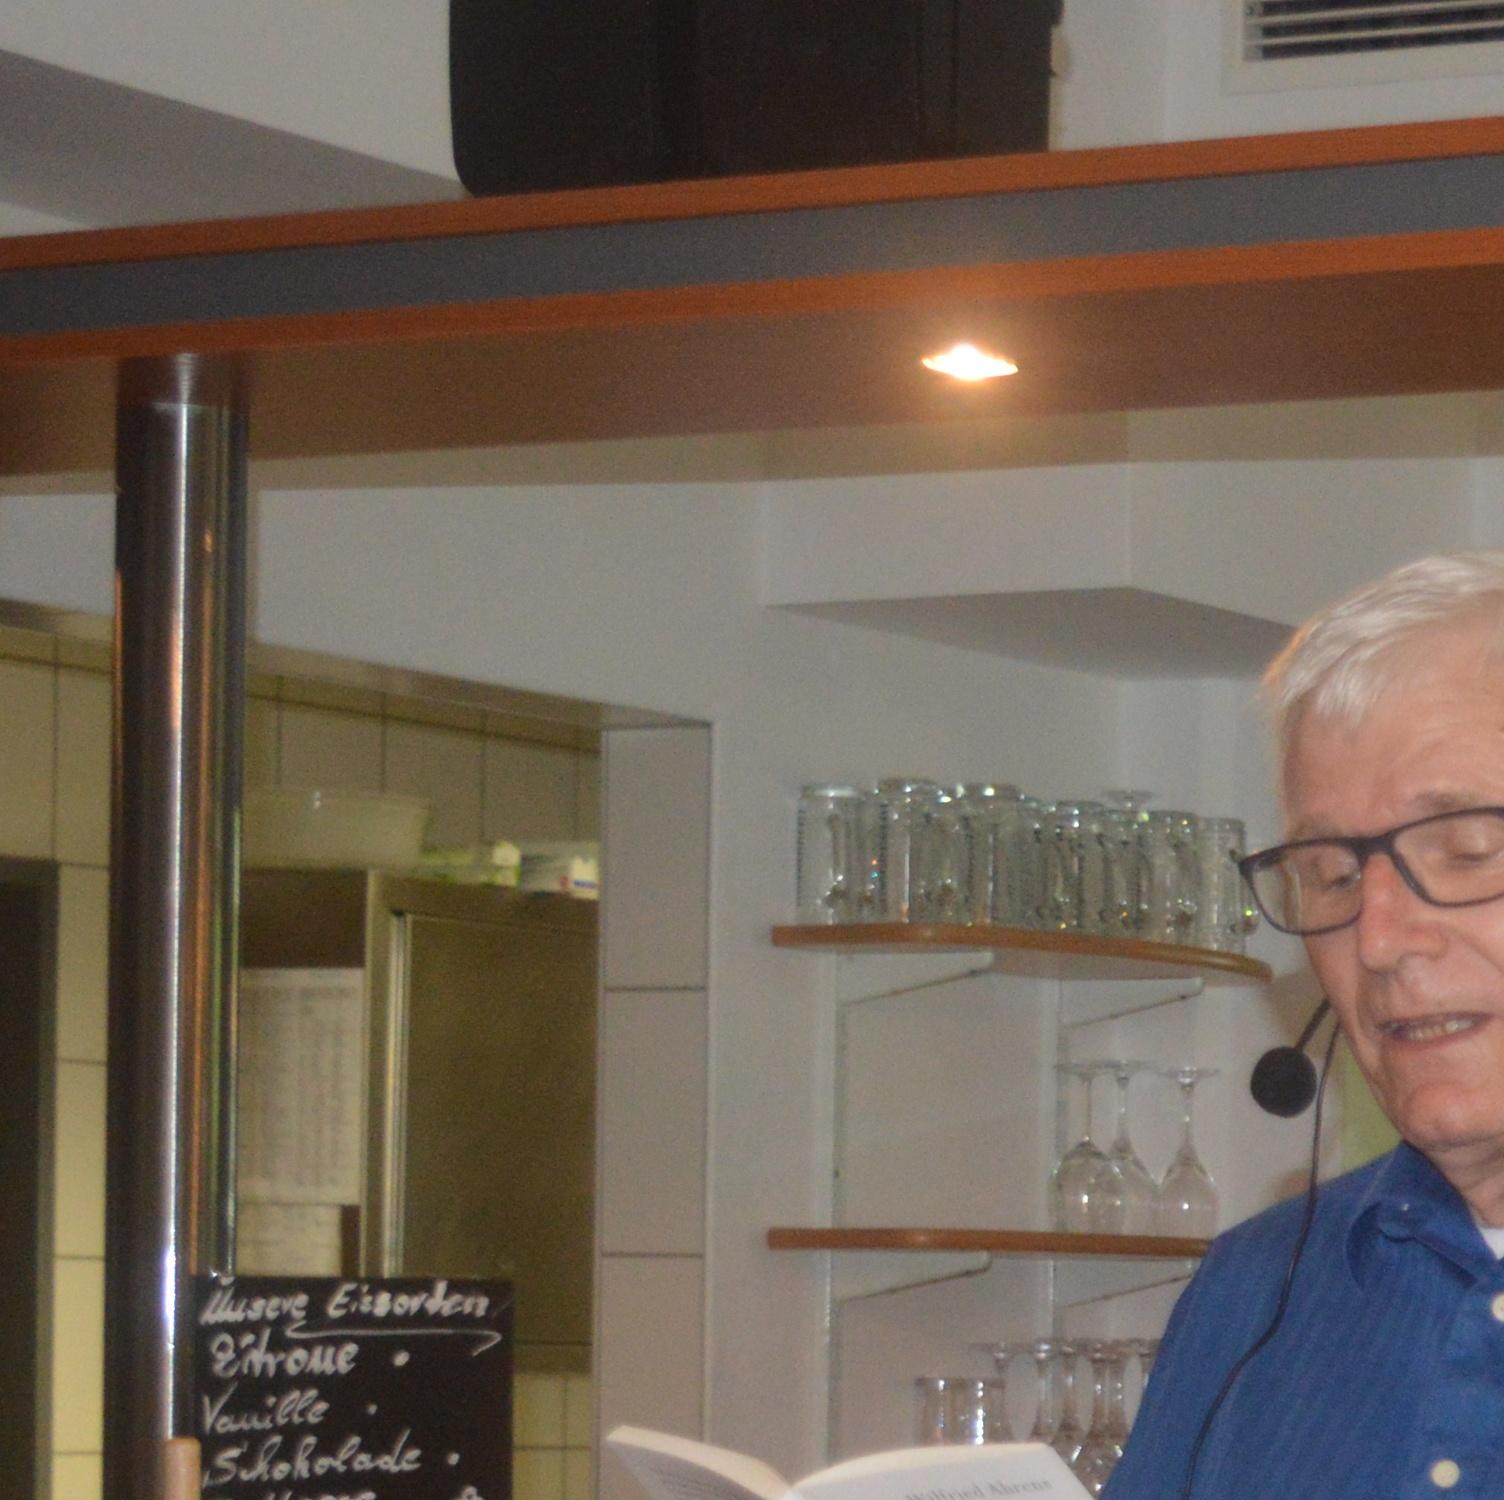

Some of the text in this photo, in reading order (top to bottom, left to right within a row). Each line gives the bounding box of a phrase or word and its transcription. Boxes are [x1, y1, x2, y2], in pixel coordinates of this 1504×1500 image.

[326, 1279, 490, 1319] Eissorten
[210, 1326, 360, 1378] Zitrone
[201, 1379, 330, 1436] Vanille
